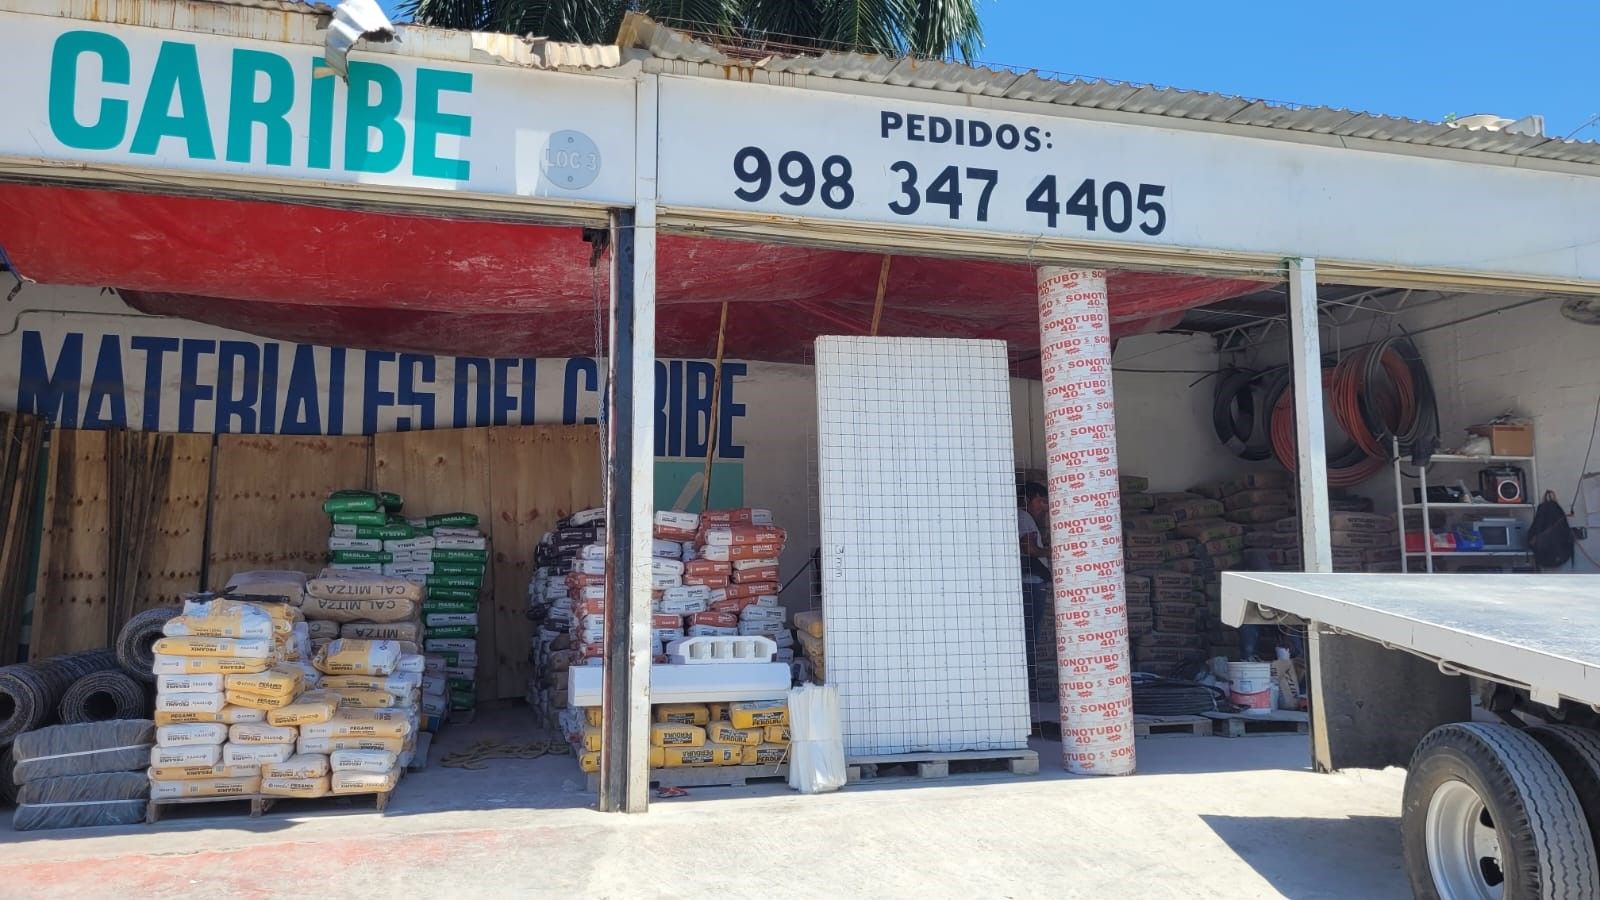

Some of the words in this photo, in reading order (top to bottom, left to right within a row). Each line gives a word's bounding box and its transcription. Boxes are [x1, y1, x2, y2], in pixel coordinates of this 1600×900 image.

[48, 30, 473, 181] CARIBE
[881, 111, 1053, 152] PEDIDOS:
[733, 146, 855, 210] 998
[888, 160, 999, 222] 347
[1026, 175, 1167, 236] 4405
[1044, 314, 1103, 331] SONOTUBO
[1050, 447, 1110, 464] SONOTUBO
[1053, 515, 1112, 530] SONOTUBO
[326, 585, 371, 594] MITZA
[376, 586, 405, 594] CAL
[1056, 584, 1116, 598] SONOTUBO
[318, 600, 360, 610] MITZA
[356, 629, 398, 639] MITZA
